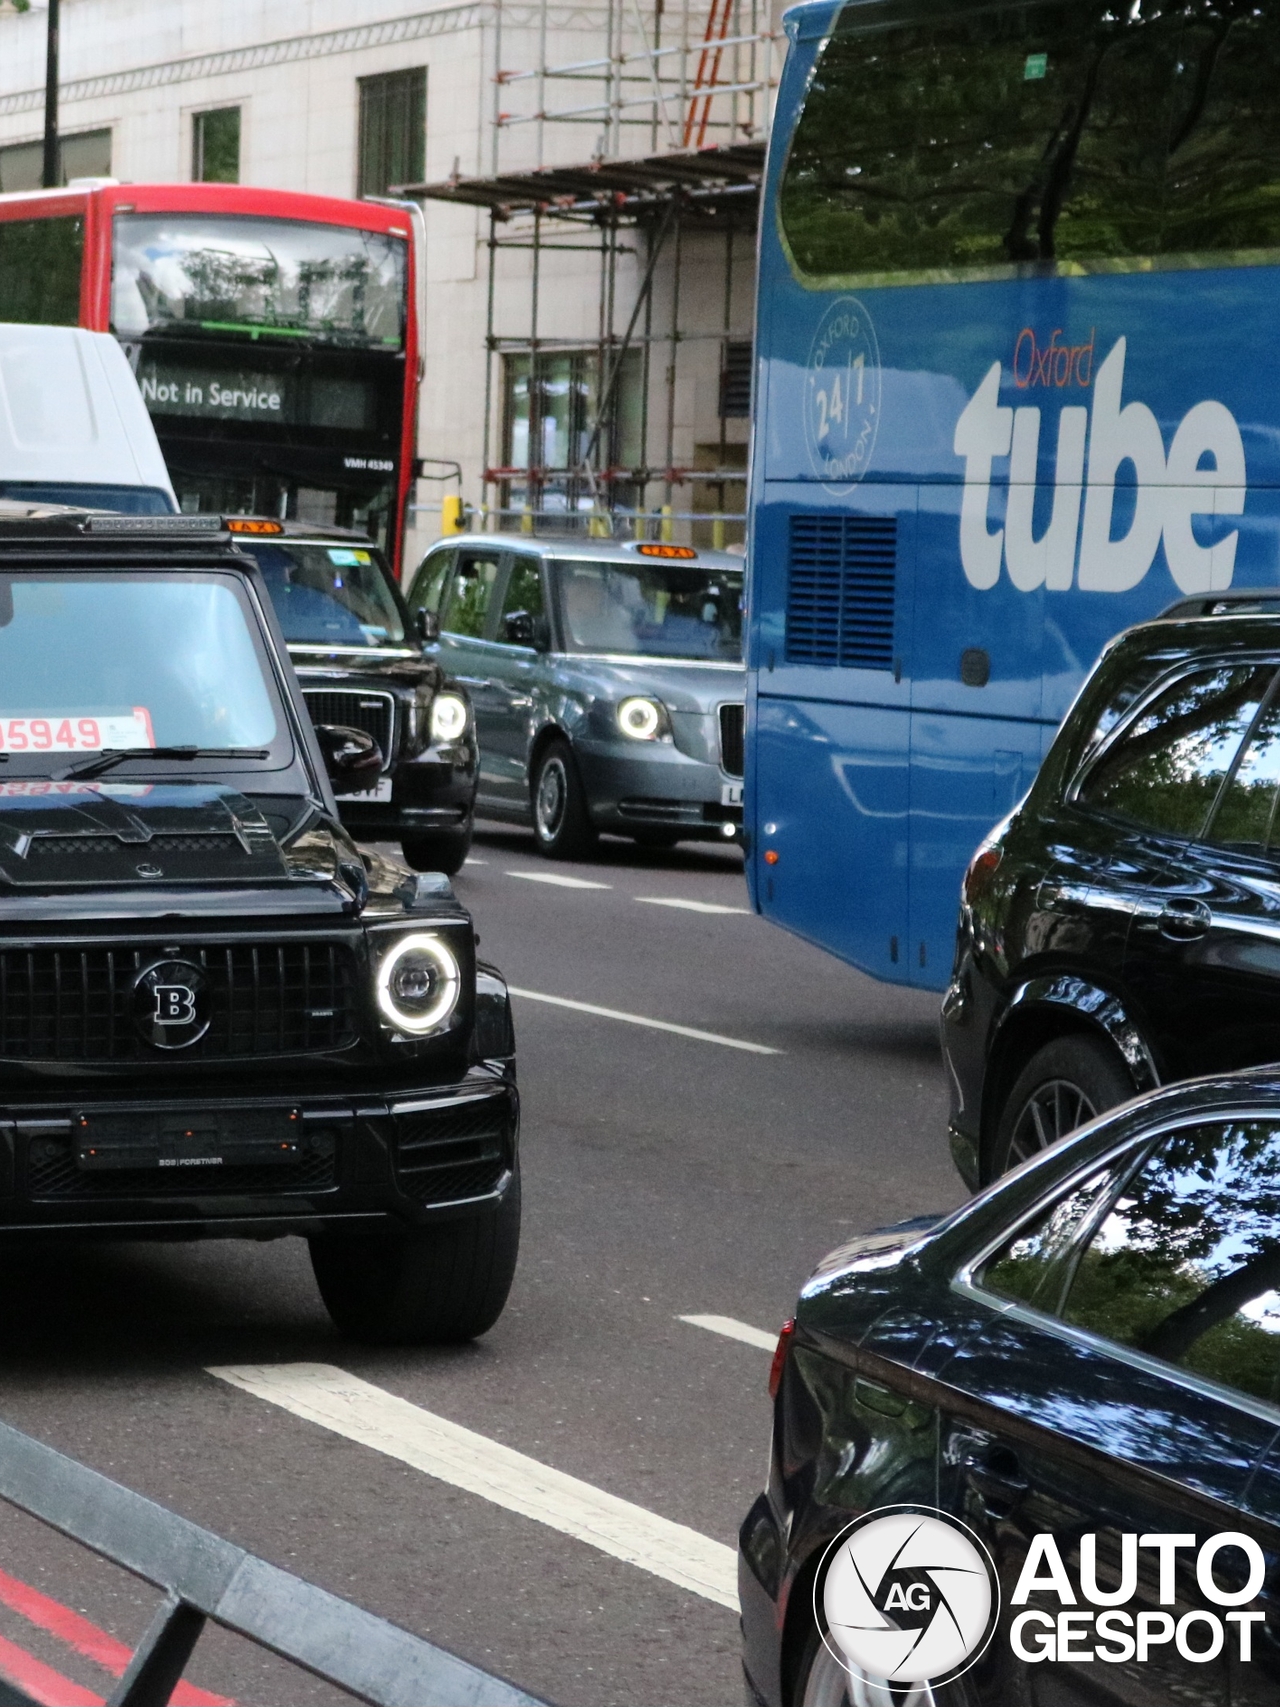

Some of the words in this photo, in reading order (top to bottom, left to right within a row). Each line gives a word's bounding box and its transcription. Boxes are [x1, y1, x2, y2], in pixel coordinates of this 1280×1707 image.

[814, 314, 860, 371] OXFORD
[1013, 327, 1095, 388] Oxford
[141, 377, 179, 402] Not
[185, 382, 203, 404] in
[209, 382, 281, 410] Service
[954, 335, 1246, 596] tube
[228, 521, 278, 532] TAXI
[154, 985, 196, 1025] B
